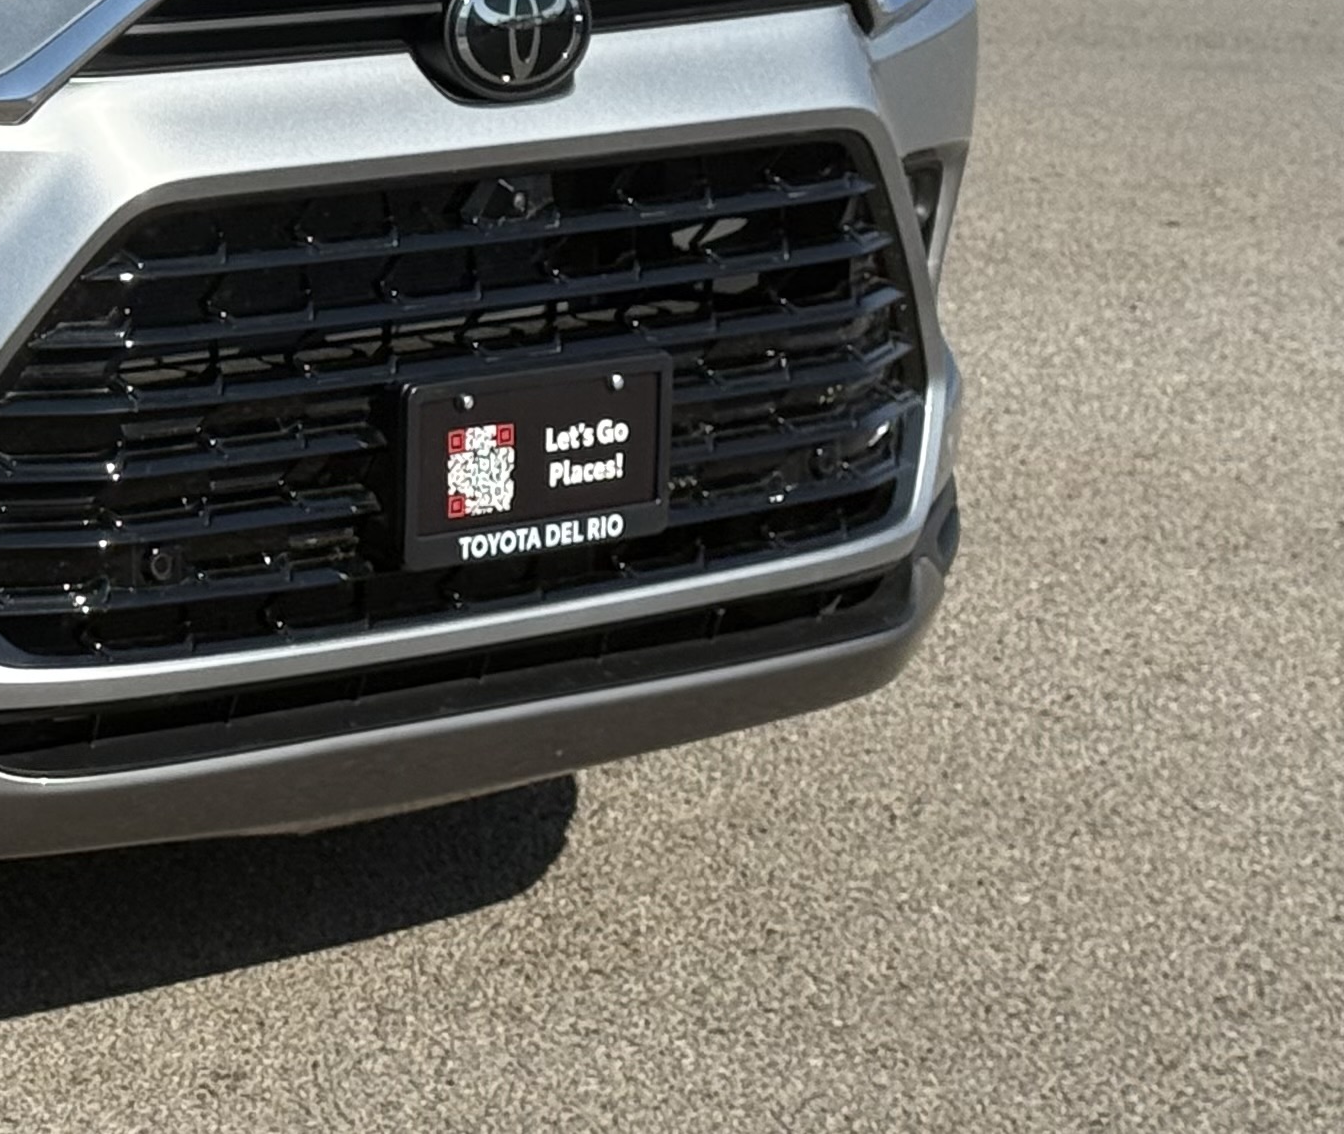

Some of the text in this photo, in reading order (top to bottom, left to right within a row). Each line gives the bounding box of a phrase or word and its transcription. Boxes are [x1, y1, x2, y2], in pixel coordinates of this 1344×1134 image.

[545, 418, 630, 453] Let's Go
[548, 452, 625, 489] Places!
[459, 513, 625, 561] TOYOTA DEL RIO
